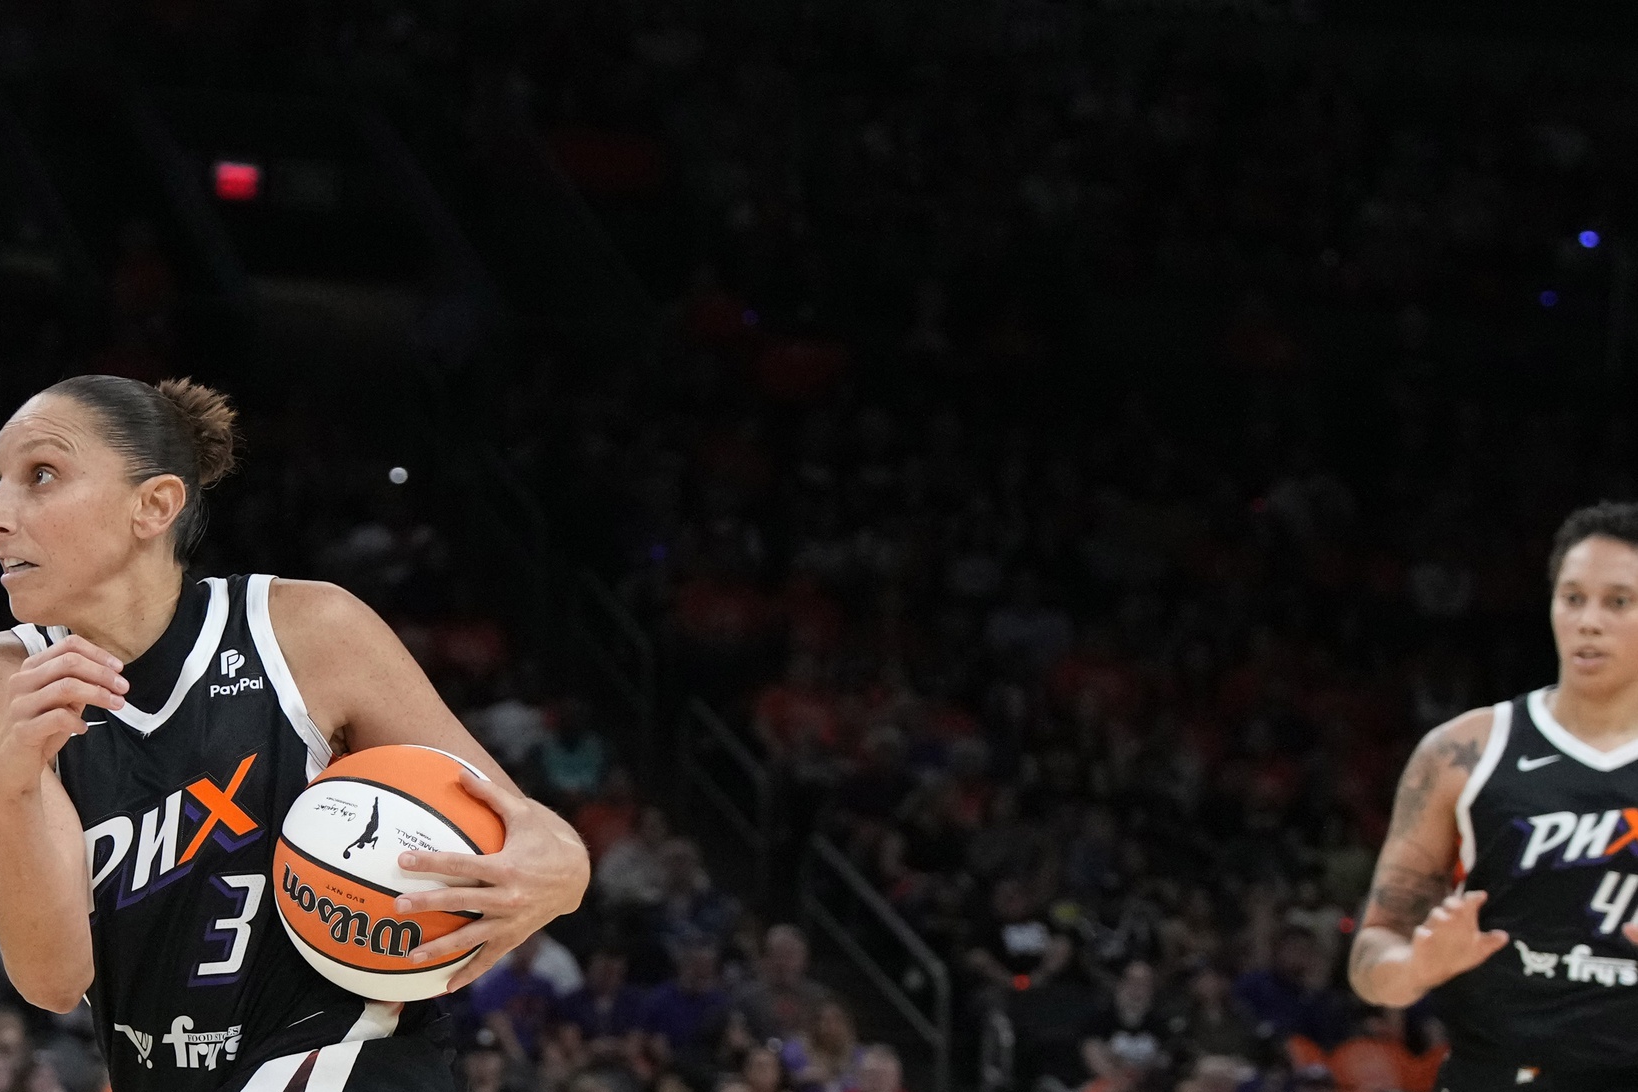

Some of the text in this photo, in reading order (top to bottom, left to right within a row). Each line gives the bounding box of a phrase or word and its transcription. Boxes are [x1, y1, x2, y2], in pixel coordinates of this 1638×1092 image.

[210, 676, 264, 698] PayPal
[83, 752, 260, 915] PHX
[395, 827, 442, 853] AME BALL
[282, 862, 423, 958] Wilson
[325, 884, 366, 904] EVO NXT
[1590, 871, 1638, 934] 4
[197, 873, 267, 976] 3
[187, 1033, 213, 1043] FOOD
